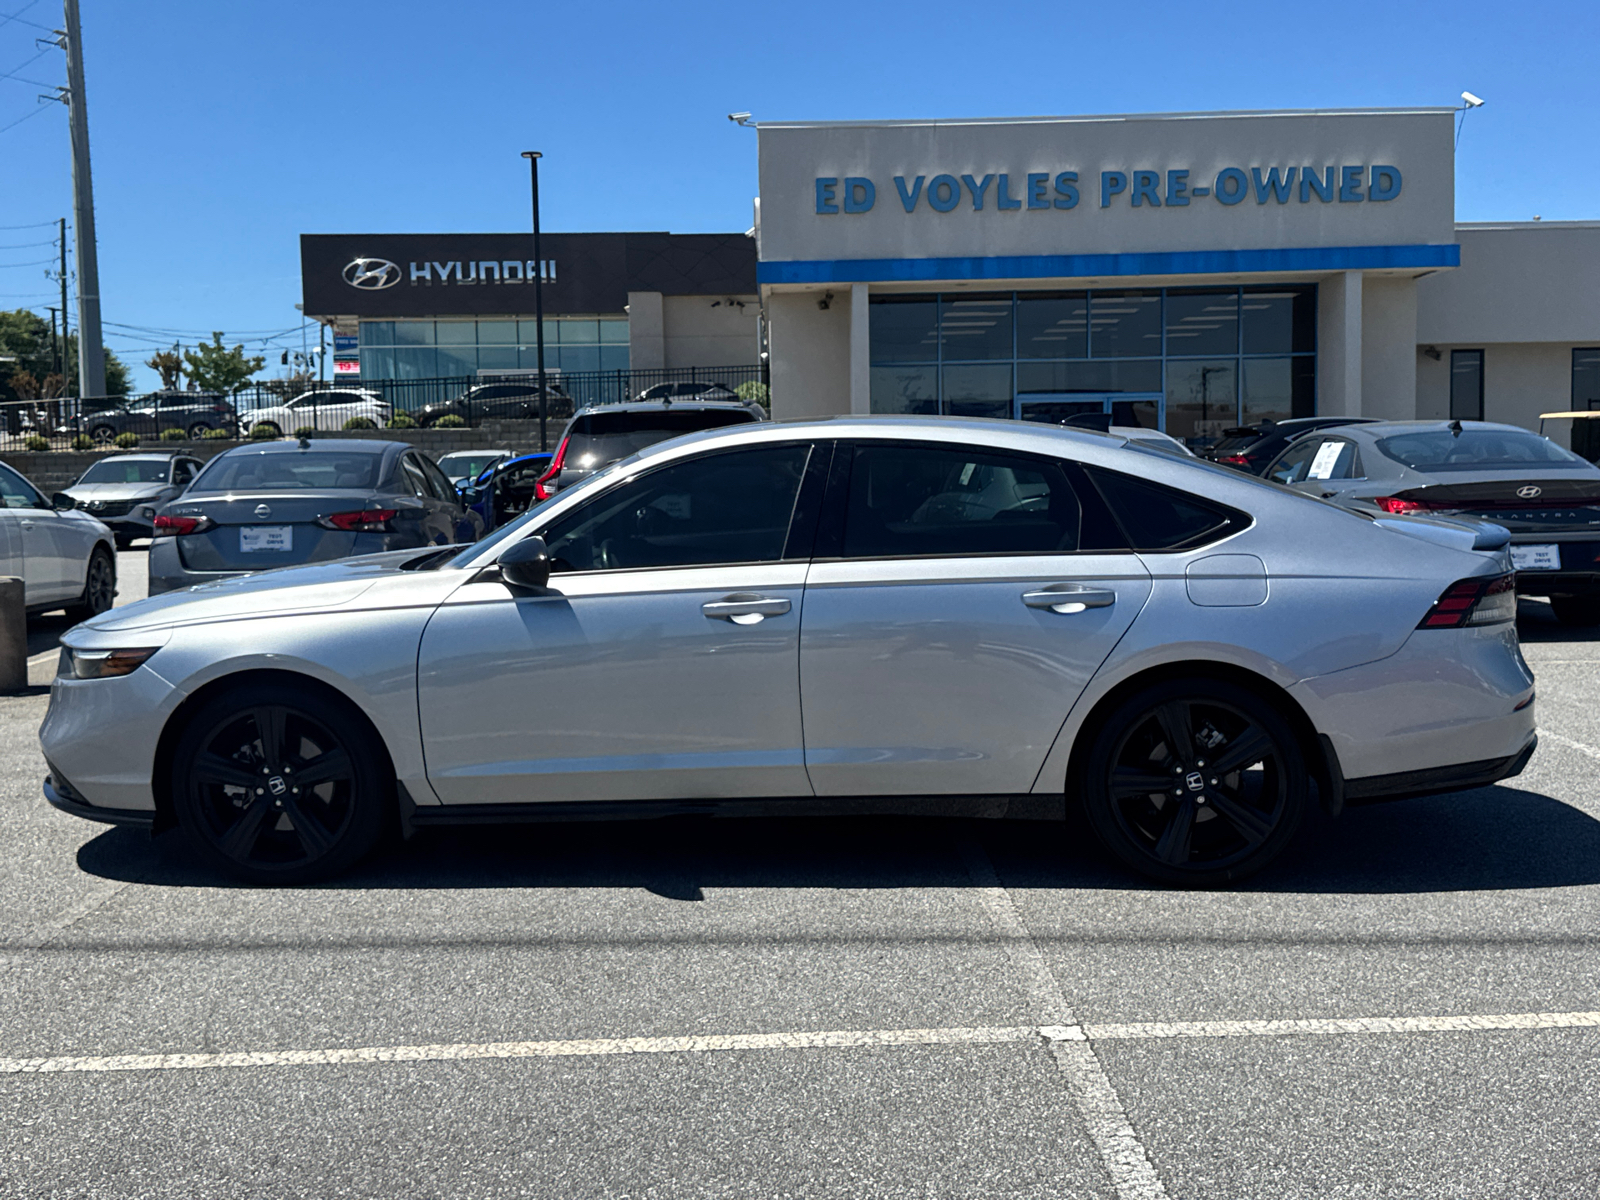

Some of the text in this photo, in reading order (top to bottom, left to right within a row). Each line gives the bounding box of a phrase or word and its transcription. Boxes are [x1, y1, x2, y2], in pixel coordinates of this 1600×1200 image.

[815, 165, 1403, 215] ED VOYLES PRE-OWNED
[409, 259, 557, 287] HYUNDAI
